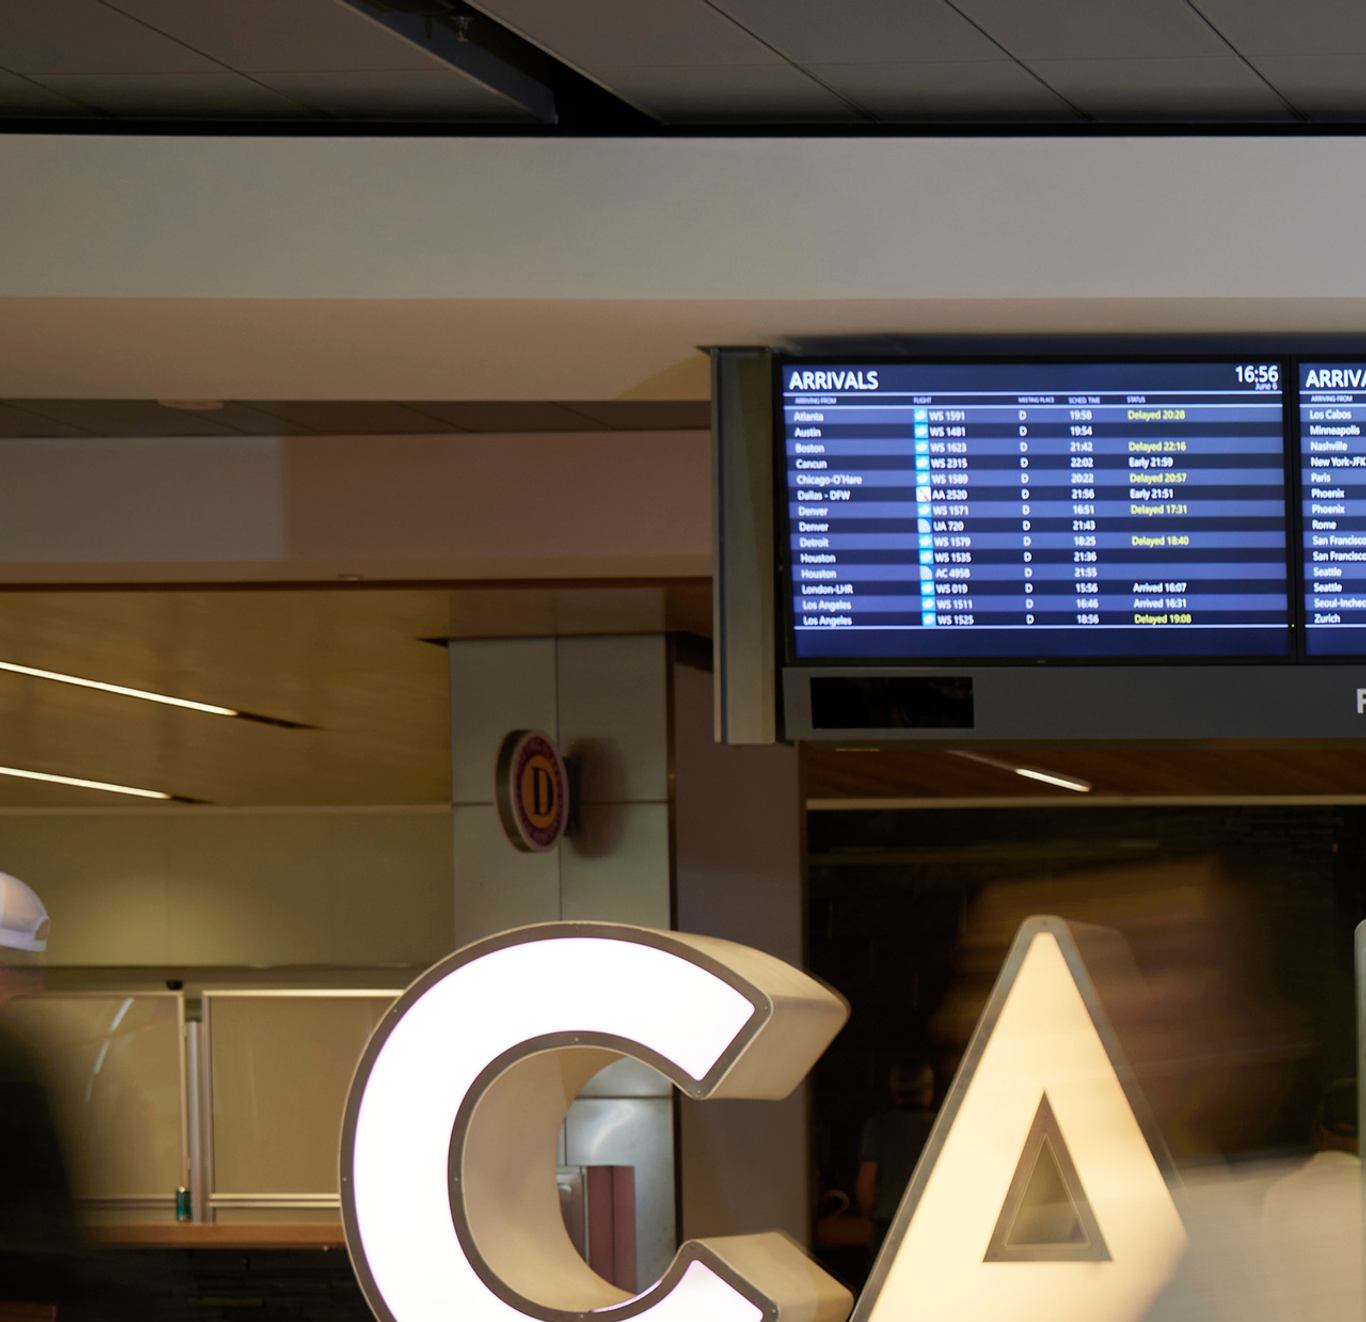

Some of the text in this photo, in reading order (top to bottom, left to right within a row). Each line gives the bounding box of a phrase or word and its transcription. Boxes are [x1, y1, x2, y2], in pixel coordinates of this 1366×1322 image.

[1235, 366, 1279, 383] 16:56
[789, 371, 879, 390] ARRIVALS
[1256, 383, 1270, 391] June
[794, 412, 824, 421] Atlanta
[1128, 410, 1161, 422] Delayed
[1310, 410, 1351, 419] Los Cabos
[795, 428, 821, 437] Austin
[1310, 425, 1360, 437] Minneapolis
[795, 443, 824, 453] Boston
[1129, 441, 1162, 453] Delayed
[1311, 441, 1347, 451] Nashville
[796, 459, 827, 469] Cancun
[1129, 457, 1149, 469] Early
[1311, 456, 1366, 467] New York-JFK
[1130, 473, 1163, 485] Delayed
[1311, 473, 1331, 482] Paris
[798, 490, 850, 500] Dallas DFW
[1130, 489, 1150, 500] Early
[1312, 488, 1344, 498] Phoenix
[799, 506, 828, 516] Denver
[1131, 505, 1164, 516] Delayed
[1312, 504, 1344, 514] Phoenix
[799, 522, 829, 532] Denver
[1312, 520, 1336, 529] Rome
[800, 538, 829, 547] Detroit
[1132, 536, 1165, 548] Delayed
[1313, 535, 1328, 545] San
[801, 553, 836, 563] Houston
[1313, 551, 1328, 561] San
[801, 569, 836, 578] Houston
[1314, 567, 1342, 576] Seattle
[802, 584, 853, 594] London-LHR
[1133, 583, 1163, 592] Arrived
[1314, 582, 1342, 592] Seattle
[803, 600, 851, 612] Los Angeles
[1134, 599, 1163, 608] Arrived
[803, 616, 852, 627] Los Angeles
[1135, 614, 1167, 625] Delayed
[1314, 614, 1340, 623] Zurich
[531, 766, 555, 817] D
